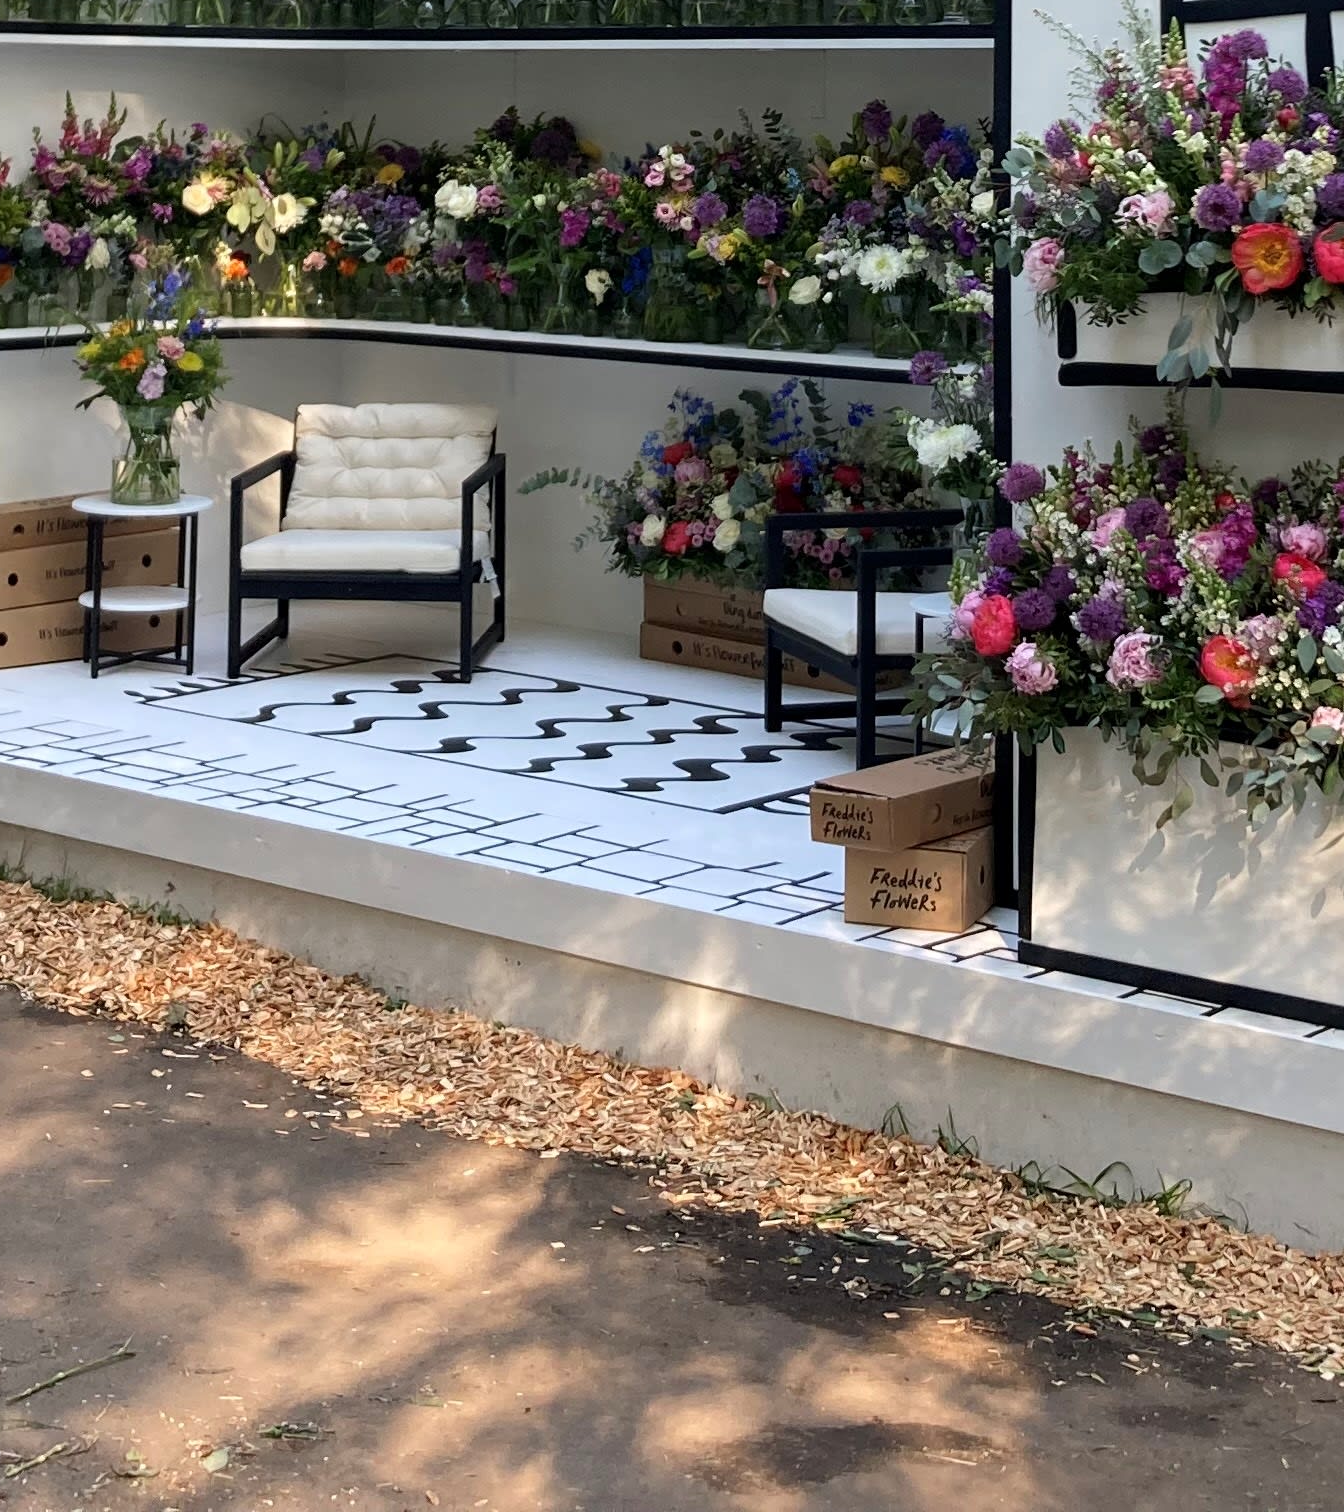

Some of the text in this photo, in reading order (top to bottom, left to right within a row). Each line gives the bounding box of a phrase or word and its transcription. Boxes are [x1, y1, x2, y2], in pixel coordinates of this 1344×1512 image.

[822, 802, 873, 824] Freddie's
[823, 821, 872, 841] Flowers
[870, 867, 942, 892] Freddie's
[870, 889, 937, 912] Flowers
